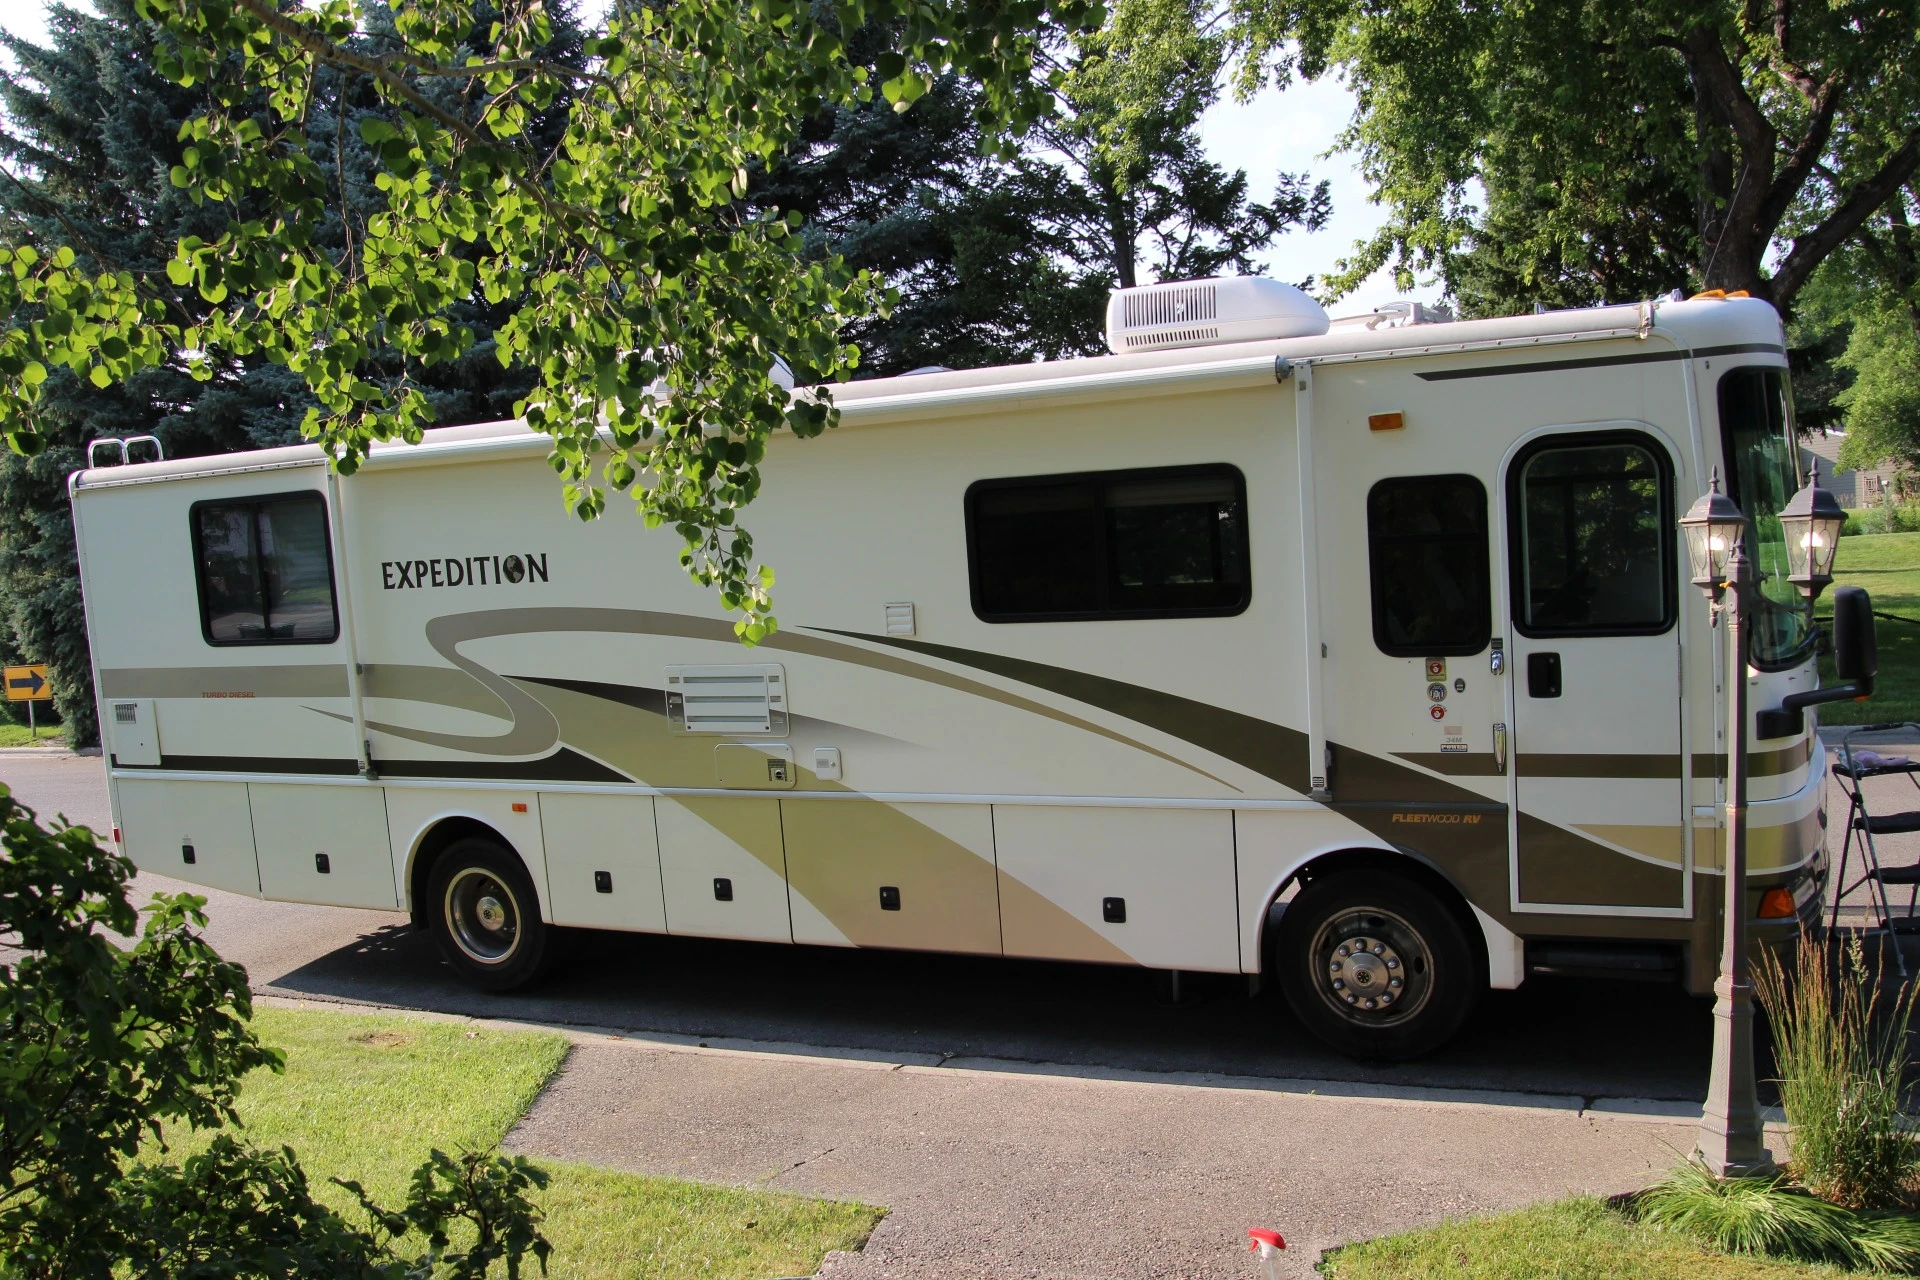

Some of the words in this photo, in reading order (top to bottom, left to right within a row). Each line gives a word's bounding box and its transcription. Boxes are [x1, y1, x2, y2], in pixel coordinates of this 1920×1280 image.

[381, 552, 549, 590] EXPEDITION
[202, 691, 228, 699] TURBO
[1391, 813, 1460, 824] FLEETWOOD
[1463, 814, 1482, 824] RV
